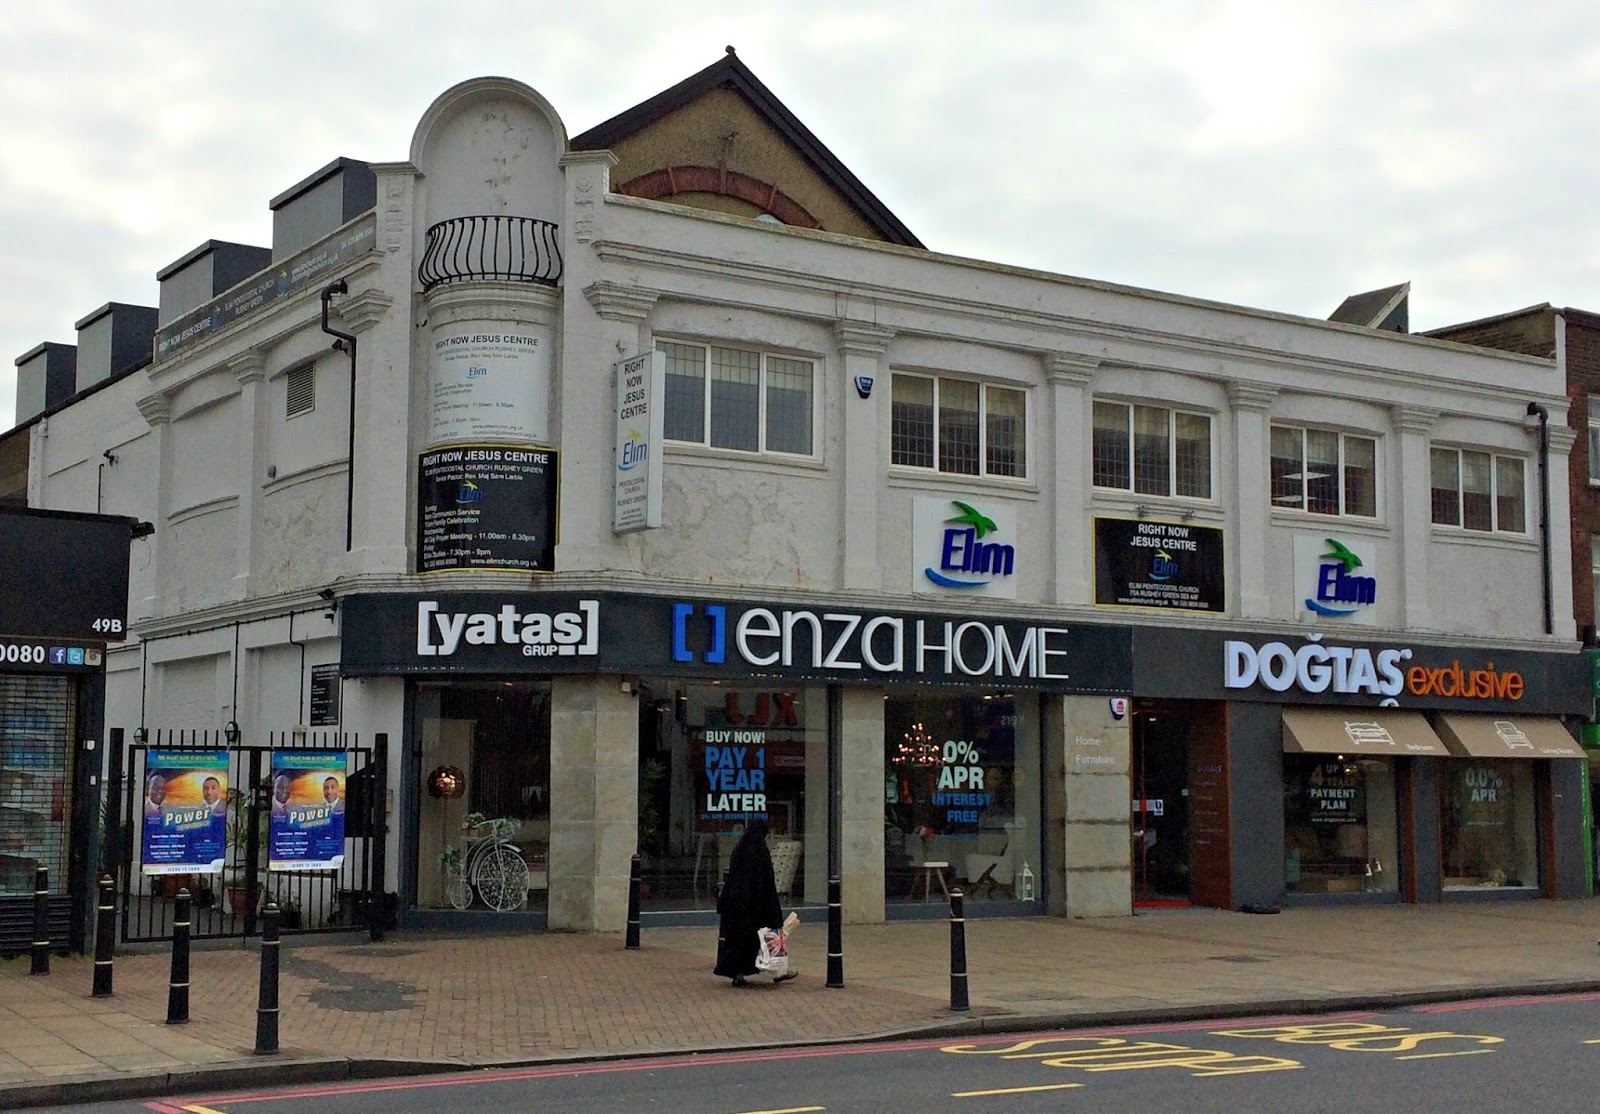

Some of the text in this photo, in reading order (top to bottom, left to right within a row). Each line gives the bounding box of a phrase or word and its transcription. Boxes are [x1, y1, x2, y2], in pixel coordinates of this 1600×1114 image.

[450, 336, 469, 346] NOW
[471, 335, 501, 343] JESUS
[503, 335, 539, 346] CENTRE
[624, 358, 645, 375] RIGHT
[626, 374, 643, 389] NOW
[623, 388, 645, 405] JESUS
[620, 402, 648, 420] CENTRE
[423, 450, 549, 467] RIGHT NOW JESUS CENTRE
[622, 439, 648, 466] Elim
[494, 464, 521, 472] RUSHEY
[522, 466, 544, 474] GREEN
[457, 508, 480, 516] Service
[1138, 523, 1189, 538] RIGHT NOW
[941, 528, 1015, 576] Elim
[1130, 536, 1197, 552] JESUS CENTRE
[1153, 558, 1178, 576] Elim
[1317, 563, 1376, 605] Elim
[92, 618, 122, 632] 49B
[522, 644, 558, 657] GRUP
[735, 607, 1069, 680] enza HOME
[1406, 659, 1524, 701] exclusive
[706, 730, 766, 744] BUY NOW!
[1075, 735, 1100, 746] Home
[705, 746, 765, 769] PAY 1
[943, 740, 979, 764] 0%
[1075, 754, 1116, 765] Furniture
[1326, 763, 1340, 774] UP
[706, 768, 765, 791] YEAR
[937, 766, 985, 790] APR
[932, 793, 993, 807] INTEREST
[1310, 788, 1356, 799] PAYMENT
[1471, 788, 1498, 803] APR
[707, 793, 767, 812] LATER
[1320, 800, 1347, 810] PLAN
[165, 808, 210, 826] Power
[289, 807, 330, 825] Power
[947, 810, 978, 823] FREE
[1208, 1022, 1505, 1051] BUS
[940, 1037, 1306, 1077] STOP
